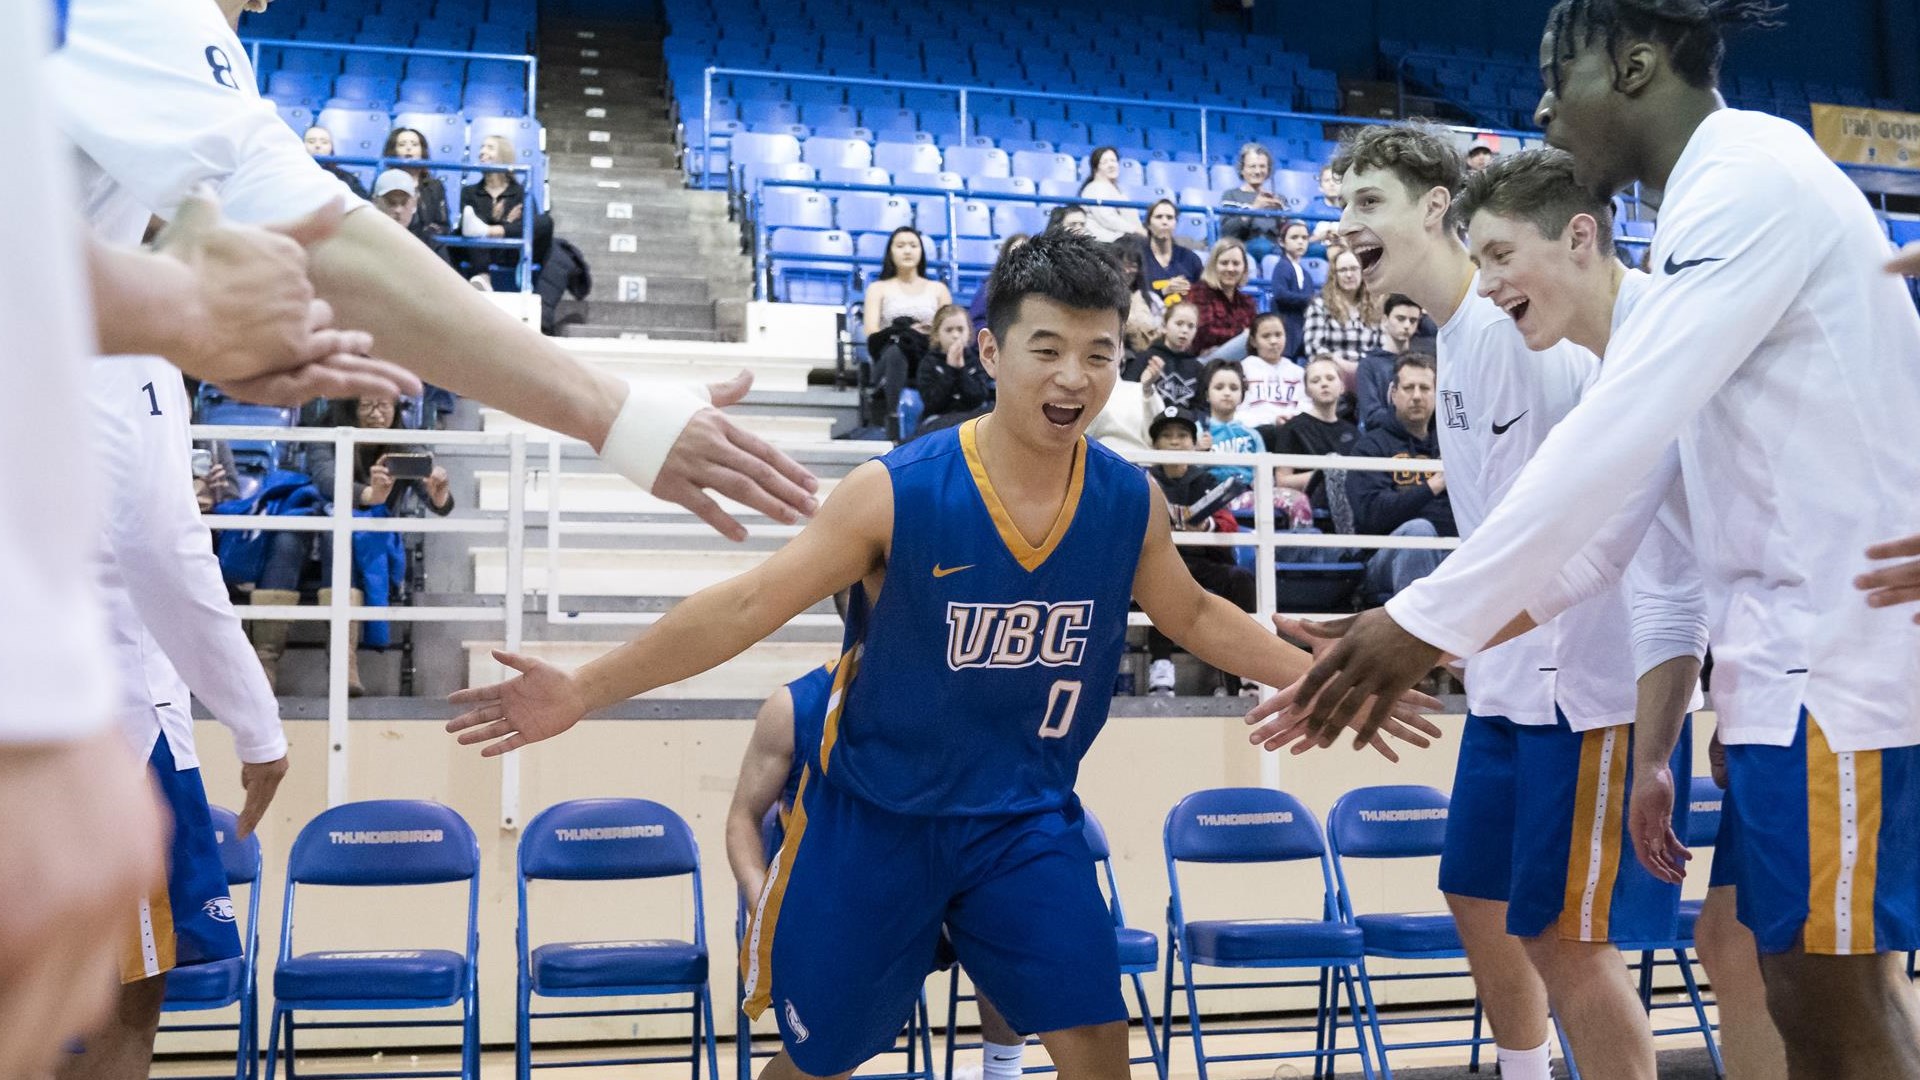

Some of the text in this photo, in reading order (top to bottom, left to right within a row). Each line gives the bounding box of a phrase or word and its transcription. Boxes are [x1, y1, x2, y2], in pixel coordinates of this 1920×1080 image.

[205, 45, 240, 90] 8
[142, 381, 163, 416] 1
[945, 599, 1095, 672] UBC
[1037, 678, 1083, 740] 0
[555, 824, 665, 842] THUNDERBIRDS
[1196, 811, 1294, 826] THUNDERBIRDS
[329, 829, 444, 844] THUNDERBIRDS
